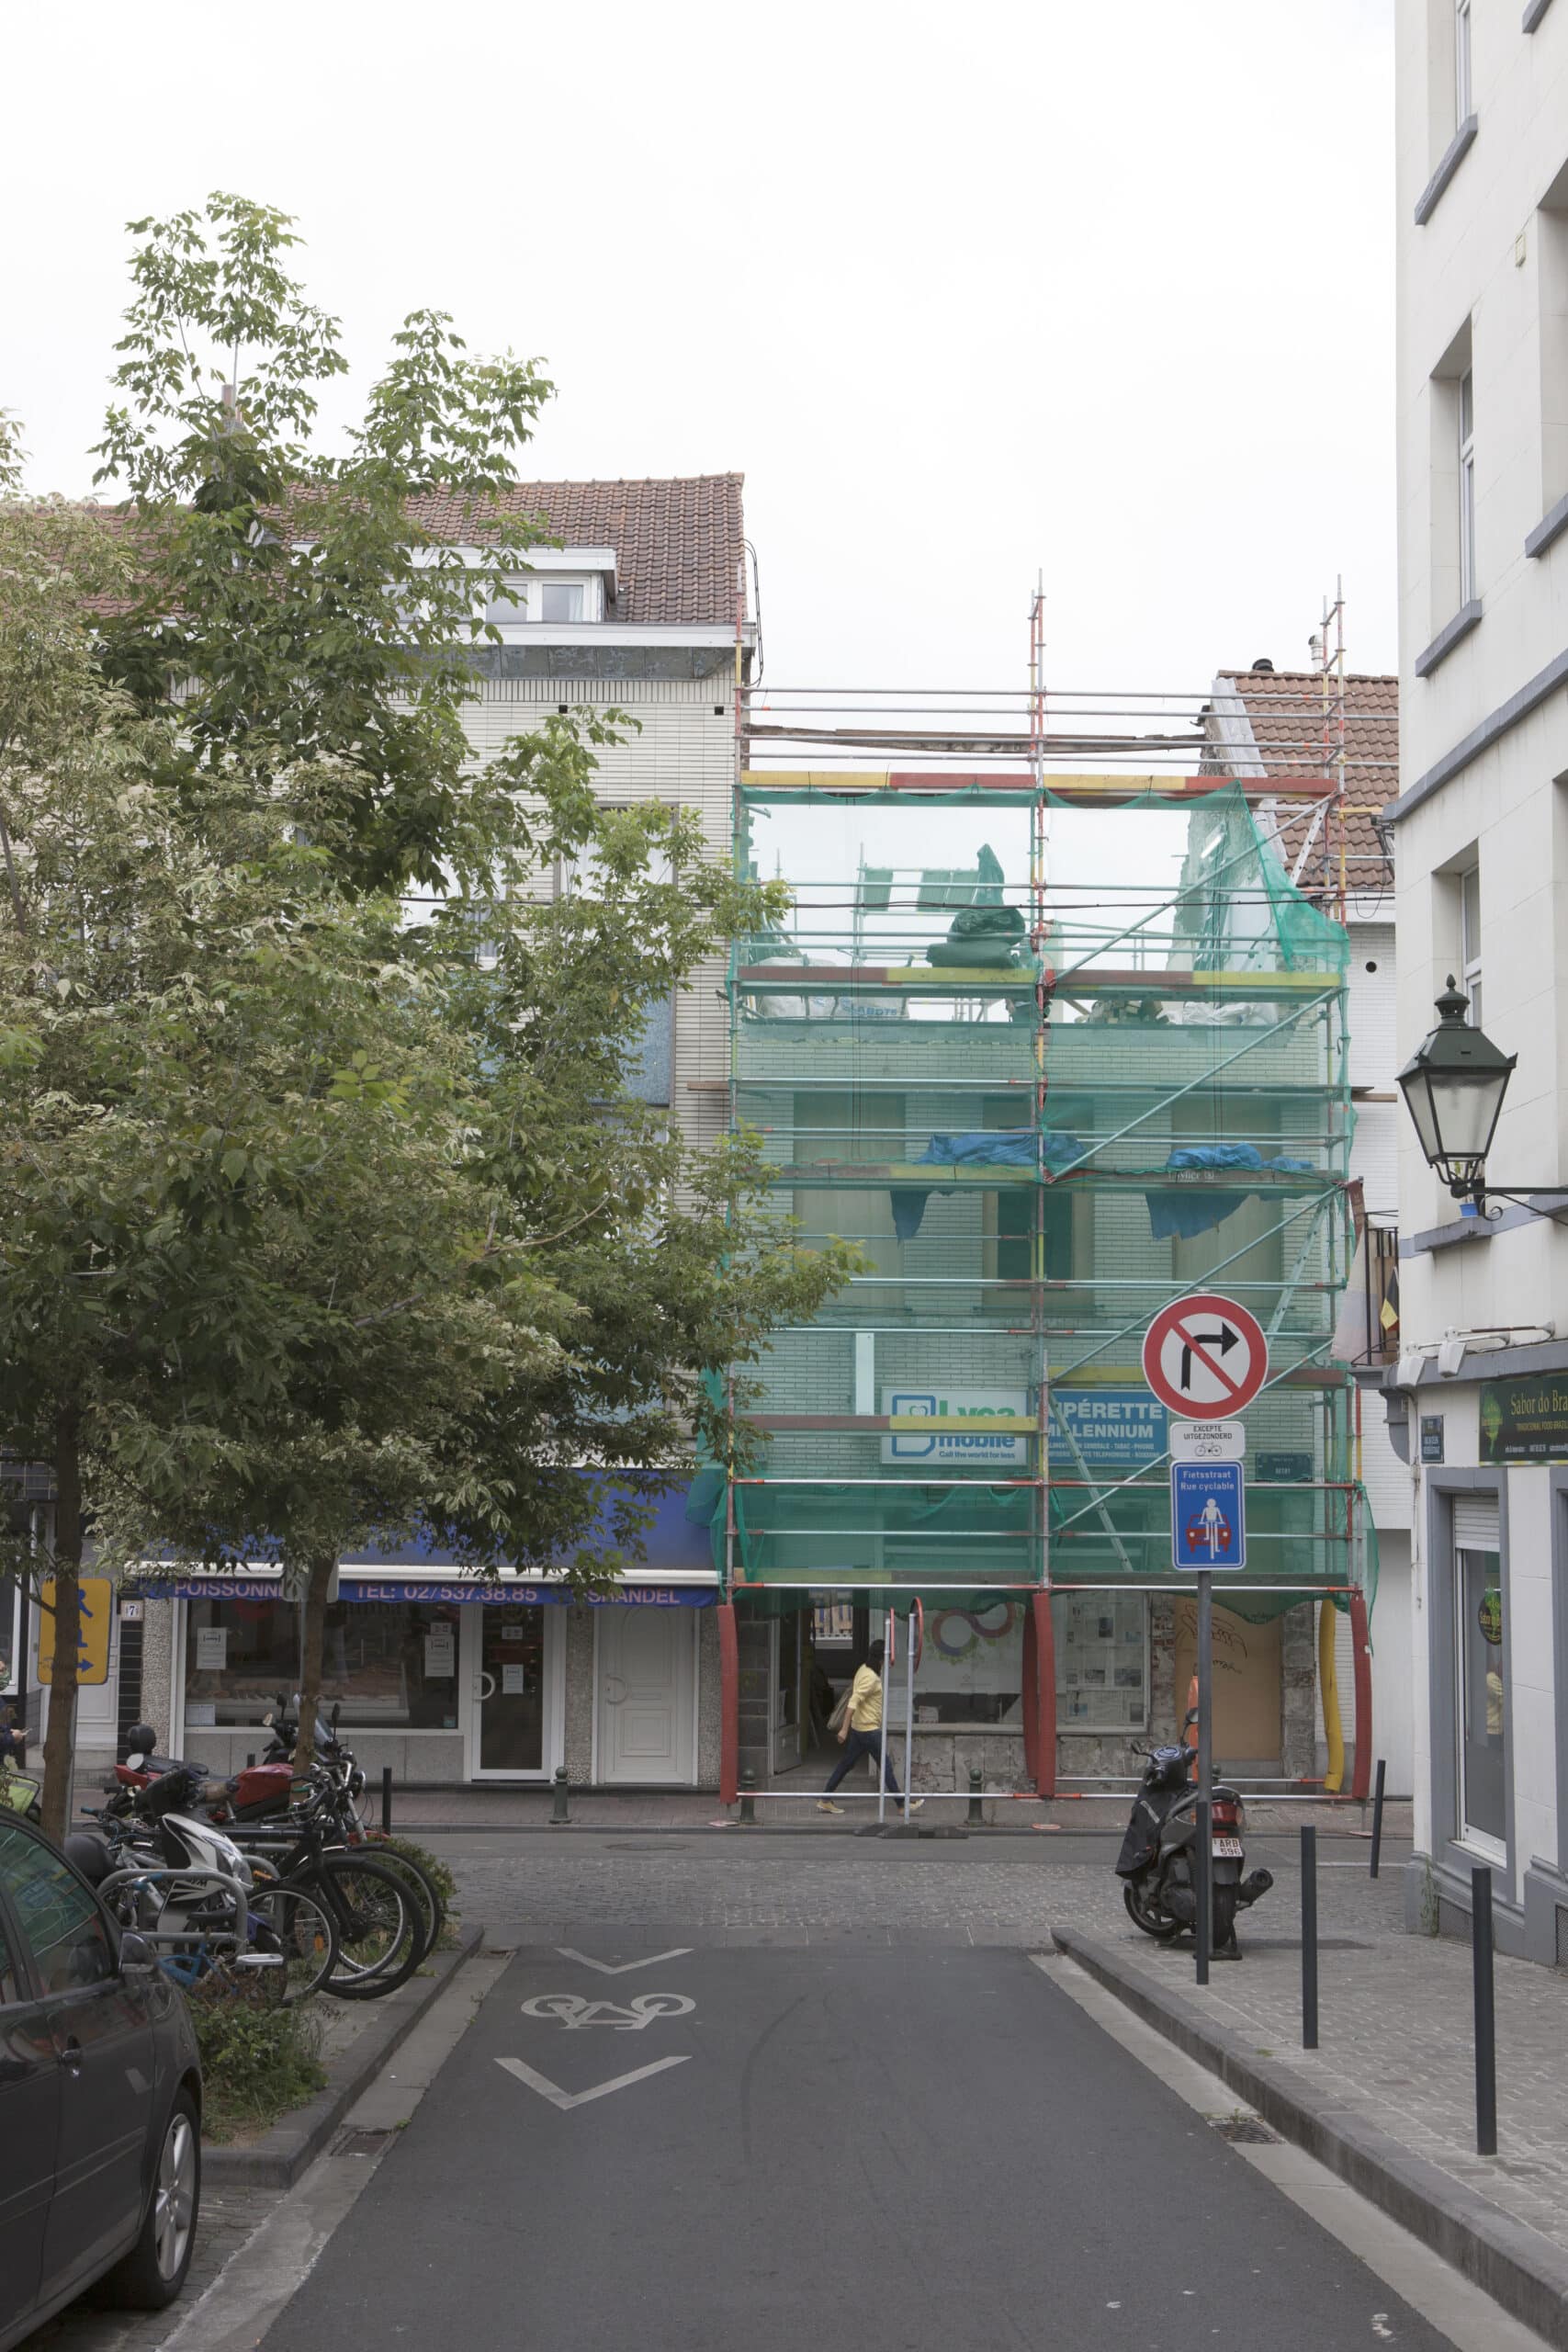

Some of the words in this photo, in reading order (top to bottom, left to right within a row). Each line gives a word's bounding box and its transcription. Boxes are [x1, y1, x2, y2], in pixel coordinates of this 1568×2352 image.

[1511, 1392, 1536, 1416] Sabor
[1538, 1389, 1550, 1413] do
[967, 1451, 988, 1459] world
[989, 1451, 999, 1459] for
[1000, 1451, 1016, 1459] less
[1182, 1470, 1231, 1478] Fietsstraat
[1180, 1482, 1198, 1490] Rue
[1199, 1482, 1235, 1492] cyclable
[175, 1579, 283, 1598] POISSONN
[355, 1582, 397, 1600] TEL:
[129, 1605, 136, 1616] 7
